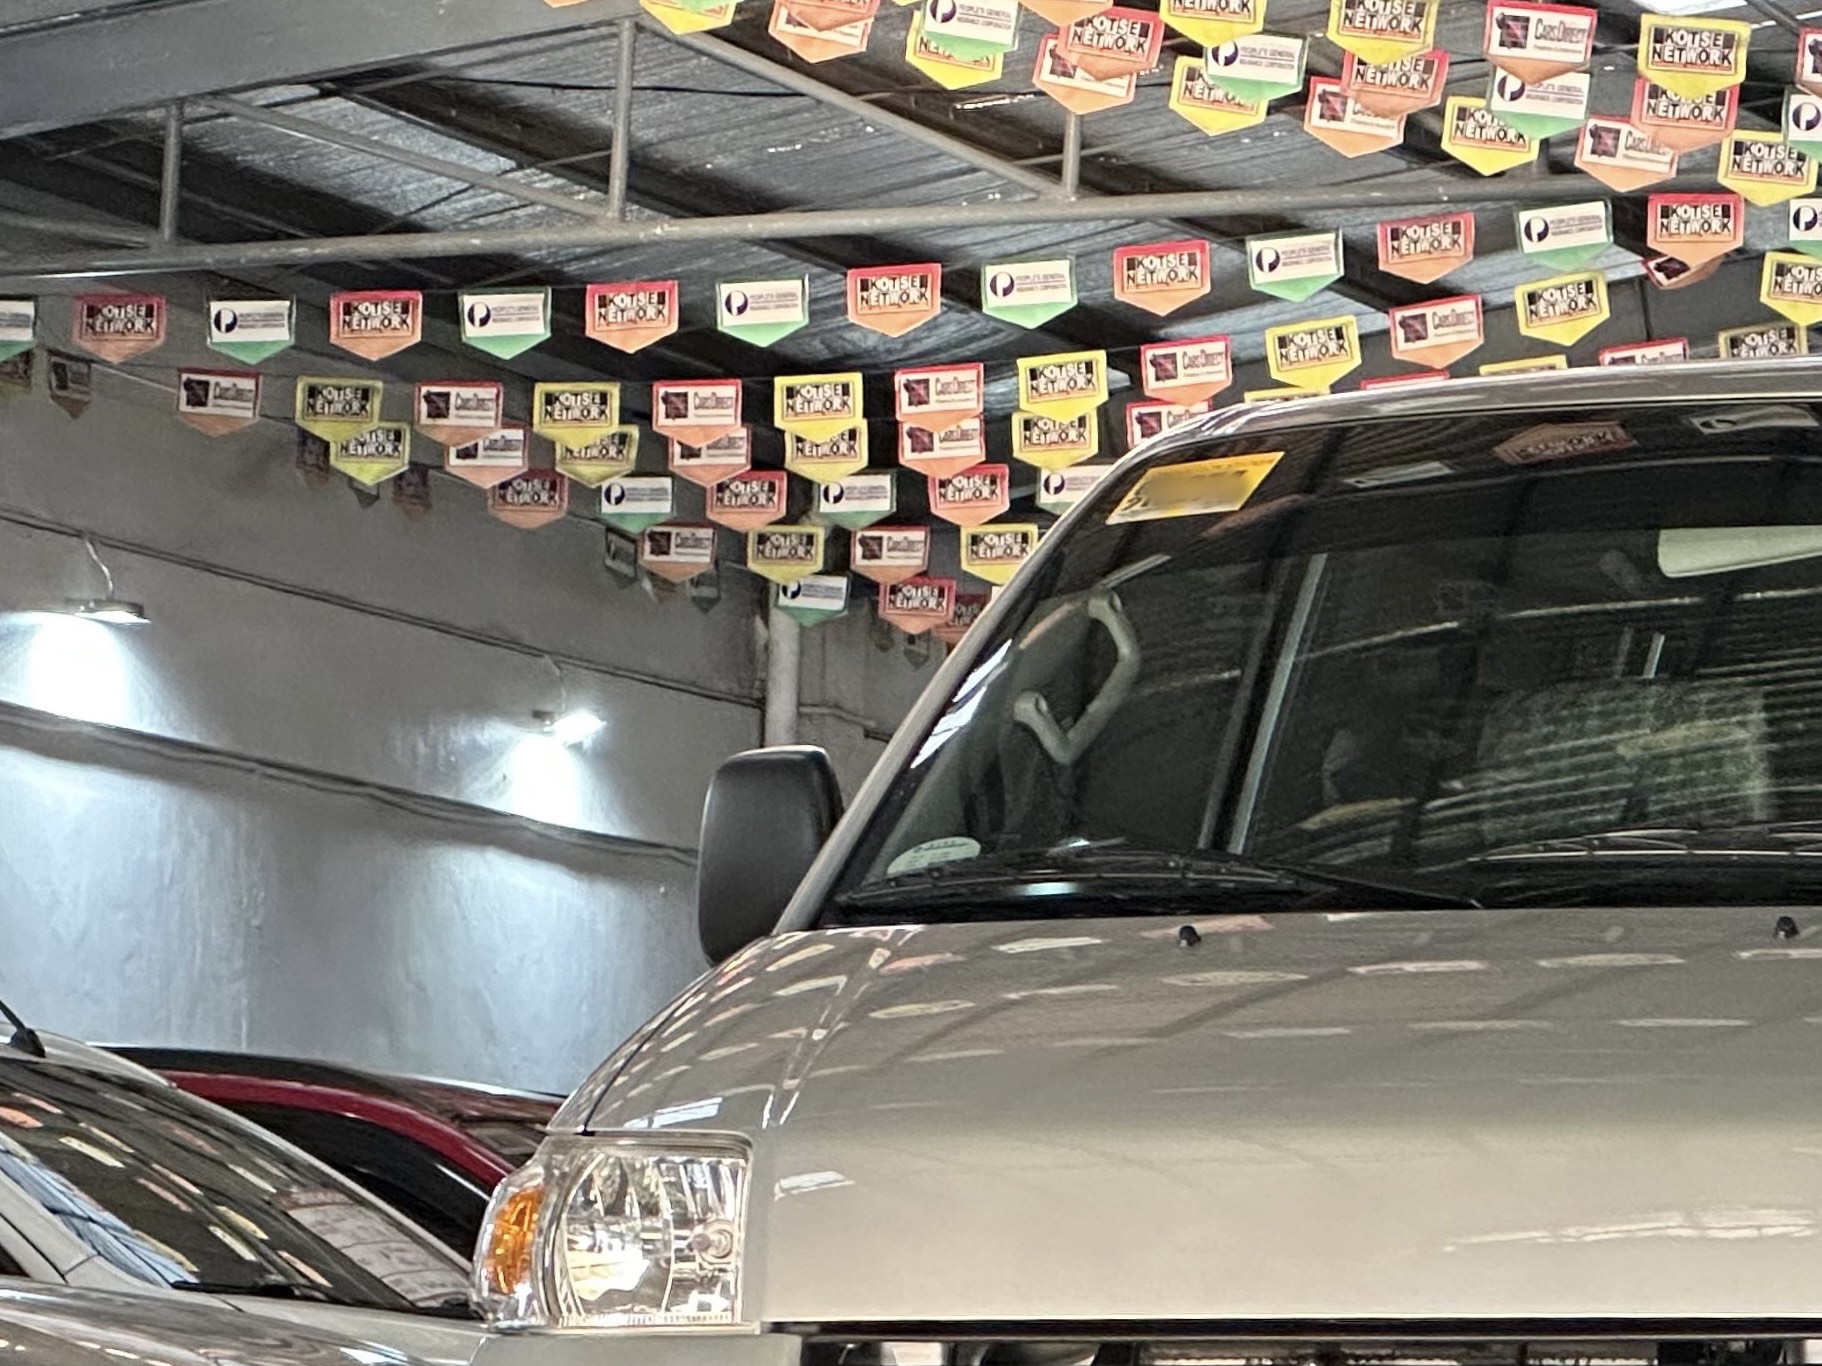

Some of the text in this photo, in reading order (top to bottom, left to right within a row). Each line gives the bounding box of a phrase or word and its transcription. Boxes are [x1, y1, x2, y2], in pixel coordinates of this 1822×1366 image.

[1356, 0, 1414, 14] KOTSE
[1085, 16, 1140, 35] KOTSE
[1344, 11, 1421, 33] NETWORK
[1071, 26, 1147, 52] NETWORK
[1666, 28, 1722, 48] KOTSE
[1652, 46, 1731, 66] NETWORK
[1356, 64, 1430, 89] NETWORK
[1469, 107, 1506, 127] KOT
[1647, 95, 1724, 122] NETWORK
[1745, 142, 1797, 160] KOTSE
[1733, 156, 1805, 176] NETWORK
[1669, 204, 1722, 219] KOTSE
[1400, 222, 1450, 239] KOTSE
[1660, 218, 1731, 234] NETWORK
[1391, 235, 1461, 255] NETWORK
[1136, 253, 1188, 272] KOTSE
[870, 276, 919, 292] KOTSE
[1127, 267, 1198, 287] NETWORK
[608, 292, 658, 308] KOTSE
[861, 290, 928, 306] NETWORK
[1538, 284, 1587, 303] KOTSE
[352, 302, 401, 319] KOTSE
[598, 307, 665, 324] NETWORK
[1529, 296, 1595, 319] NETWORK
[85, 318, 156, 334] NETWORK
[343, 315, 409, 330] NETWORK
[1287, 327, 1336, 348] KOTSE
[1278, 342, 1348, 362] NETWORK
[1038, 362, 1086, 379] KOTSE
[794, 384, 842, 400] KOTSE
[1030, 375, 1095, 395] NETWORK
[306, 399, 371, 414] NETWORK
[554, 392, 599, 406] KOTSE
[786, 398, 851, 414] NETWORK
[544, 405, 610, 421] NETWORK
[1022, 427, 1086, 444] NETWORK
[937, 486, 1001, 502] NETWORK
